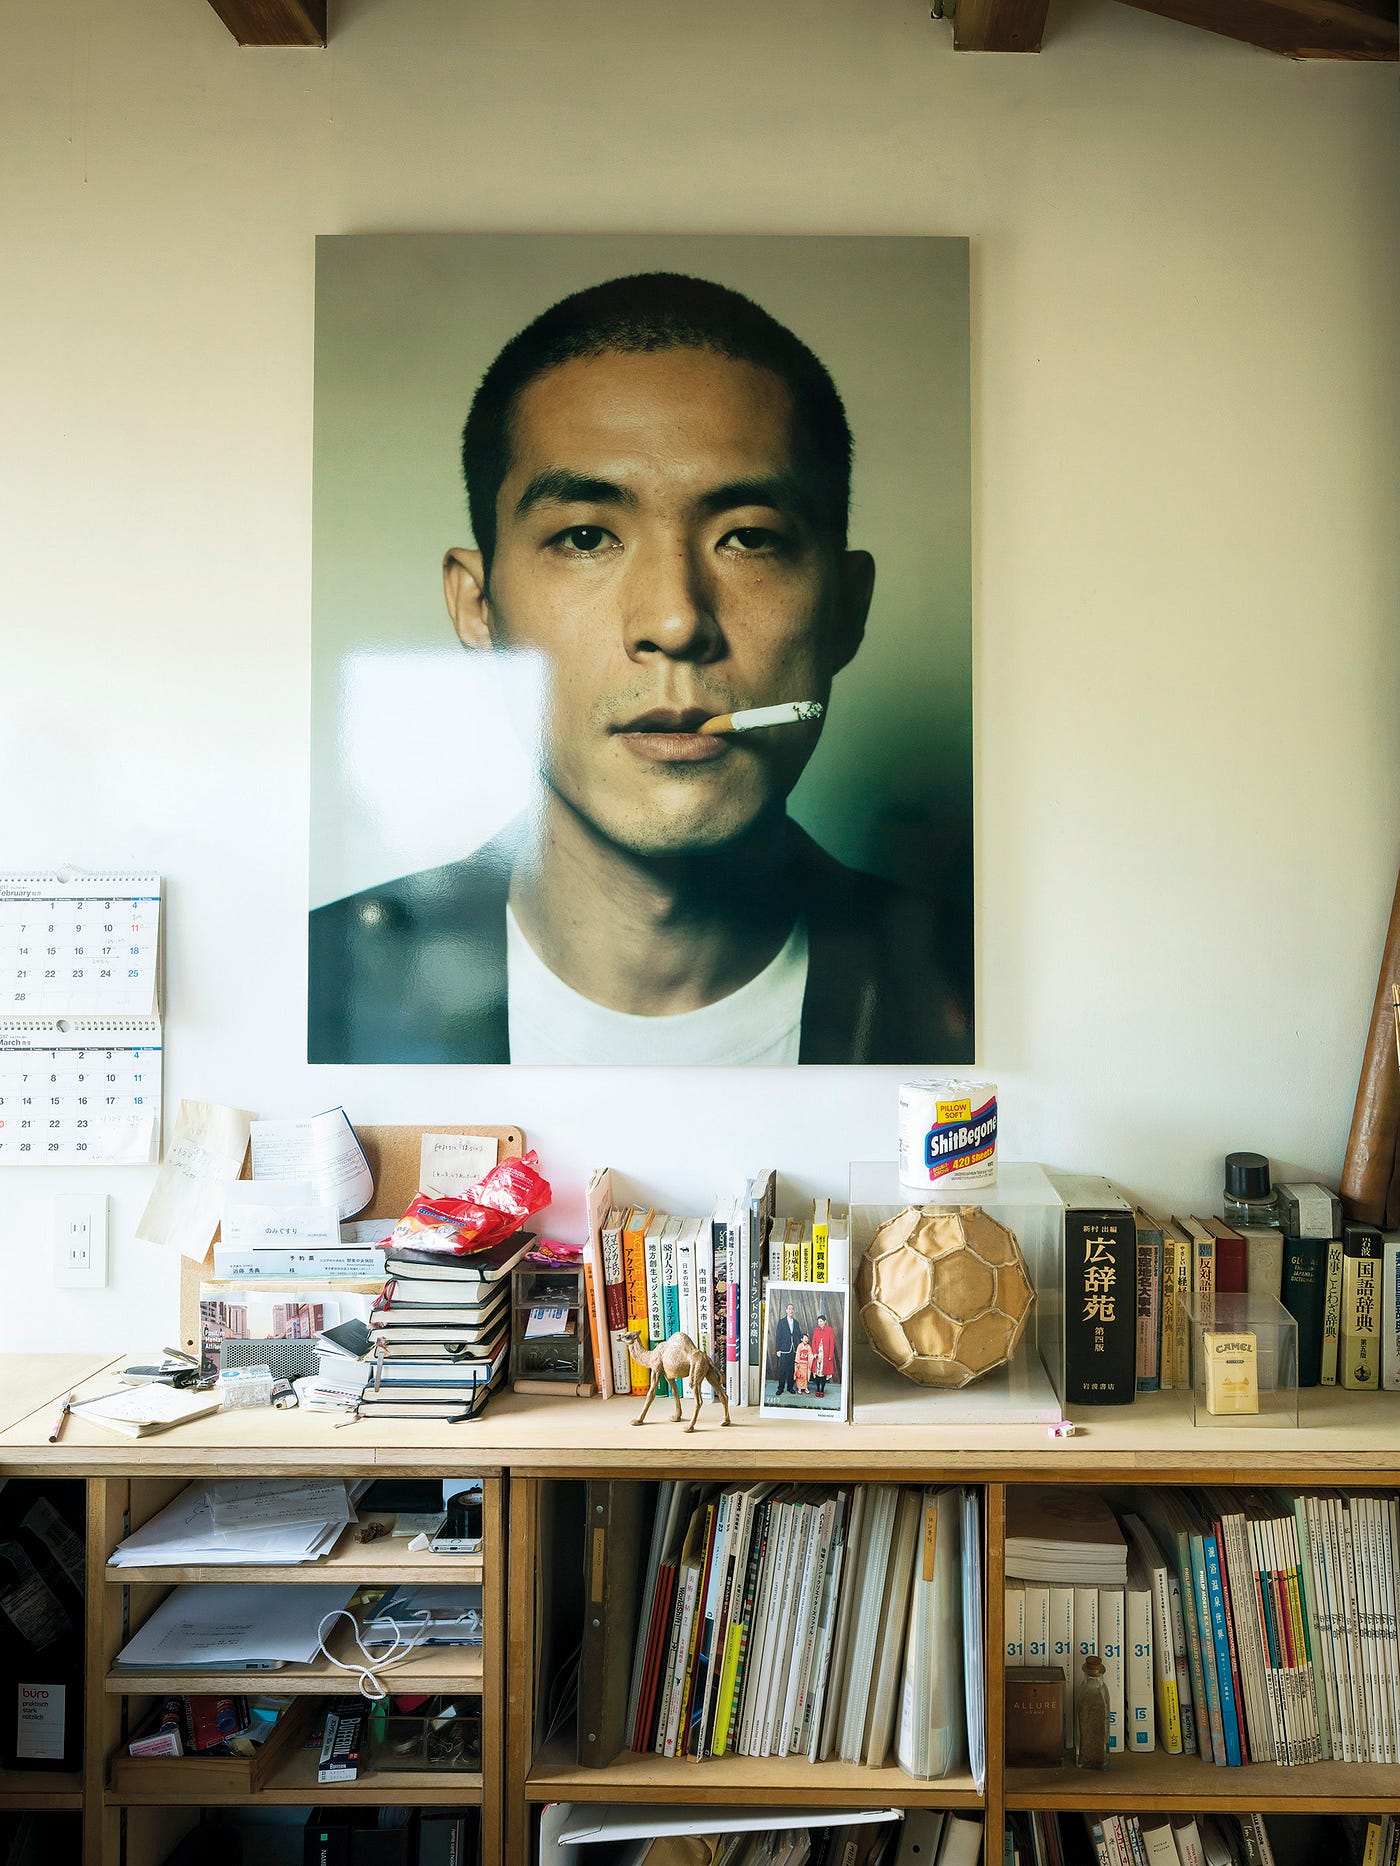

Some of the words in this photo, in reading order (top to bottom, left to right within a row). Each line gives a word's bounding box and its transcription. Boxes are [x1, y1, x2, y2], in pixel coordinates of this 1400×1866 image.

[14, 993, 26, 1001] 28
[134, 1074, 142, 1082] 11
[940, 1104, 967, 1112] PILLOW
[930, 1115, 997, 1157] ShitBegone
[952, 1156, 970, 1169] 420
[971, 1148, 993, 1163] Sheets
[1083, 1225, 1099, 1233] 新村
[1101, 1225, 1118, 1233] 出編
[610, 1232, 620, 1276] ゴエンカ氏の
[630, 1231, 643, 1275] ACTIVE
[1361, 1237, 1371, 1257] 岩波
[816, 1252, 825, 1283] 買物欲
[648, 1243, 661, 1338] 地方創生ビジネスの教科書
[663, 1243, 676, 1337] 88万人のコミュニティデザイ
[1082, 1237, 1117, 1322] 広辞苑
[635, 1280, 646, 1311] HOPE
[699, 1268, 708, 1334] 内田樹の大市民
[750, 1261, 759, 1345] ポートランドの小商い
[1326, 1249, 1341, 1339] 故事ことわざ辞典
[1355, 1261, 1375, 1332] 国語辞典
[1094, 1326, 1105, 1352] 第四版
[1216, 1343, 1253, 1353] CAMEL
[674, 1587, 685, 1625] WorldShift
[1200, 1590, 1208, 1613] MORRIS
[1007, 1643, 1023, 1655] 31
[1030, 1642, 1046, 1655] 31
[1055, 1642, 1071, 1654] 31
[1080, 1642, 1095, 1655] 31
[1105, 1645, 1120, 1657] 31
[1135, 1644, 1150, 1657] 31
[22, 1688, 49, 1698] büro
[1014, 1701, 1057, 1709] ALLURE
[333, 1717, 361, 1756] BUFFERIN
[1255, 1824, 1264, 1845] DECOR
